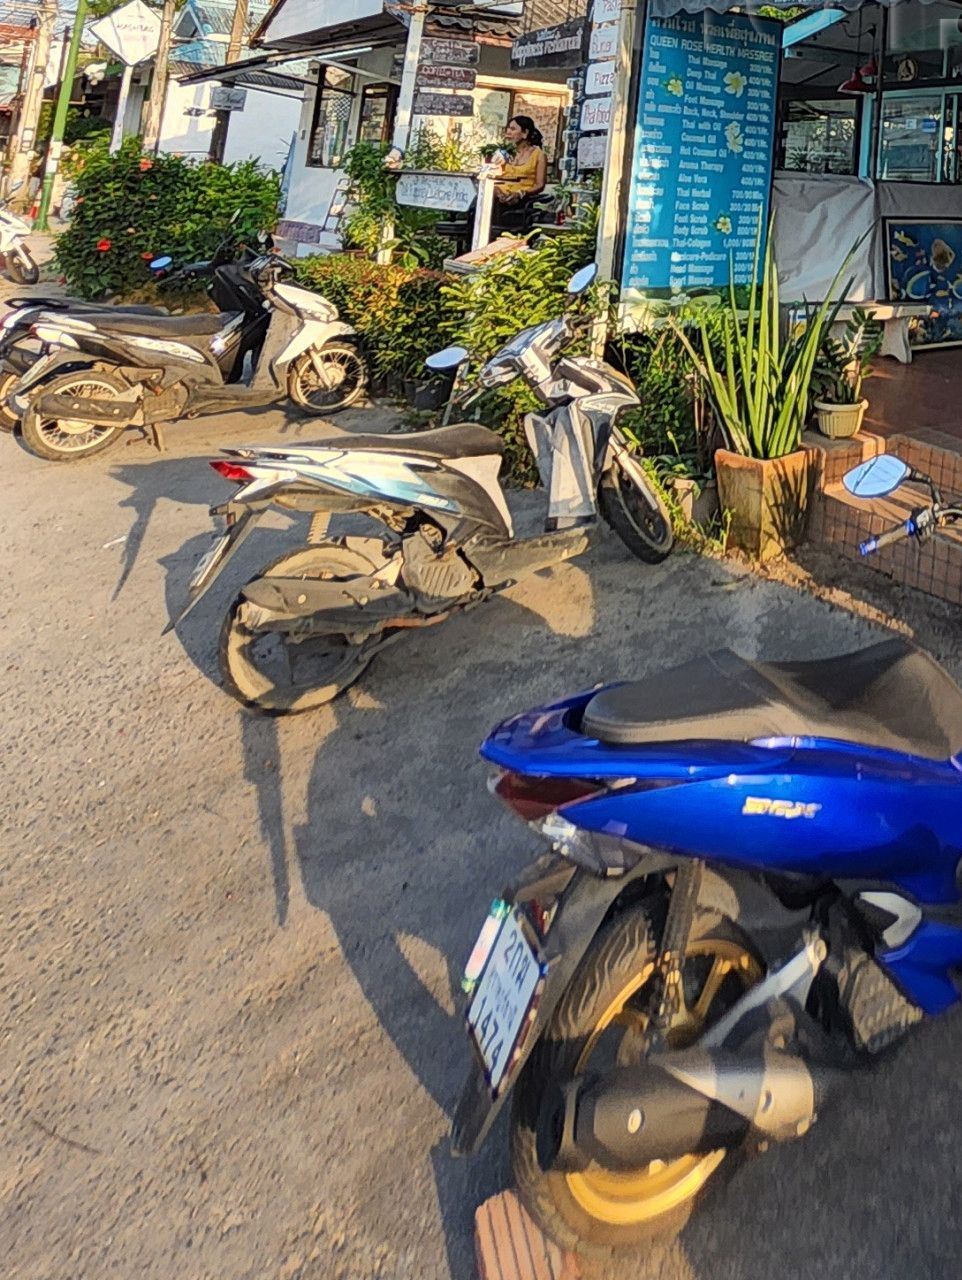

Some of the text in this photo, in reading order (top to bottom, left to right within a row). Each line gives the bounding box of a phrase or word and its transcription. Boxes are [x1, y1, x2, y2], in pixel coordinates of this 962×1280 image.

[650, 35, 775, 63] QUEEN ROSE HEALTH MASSAGE
